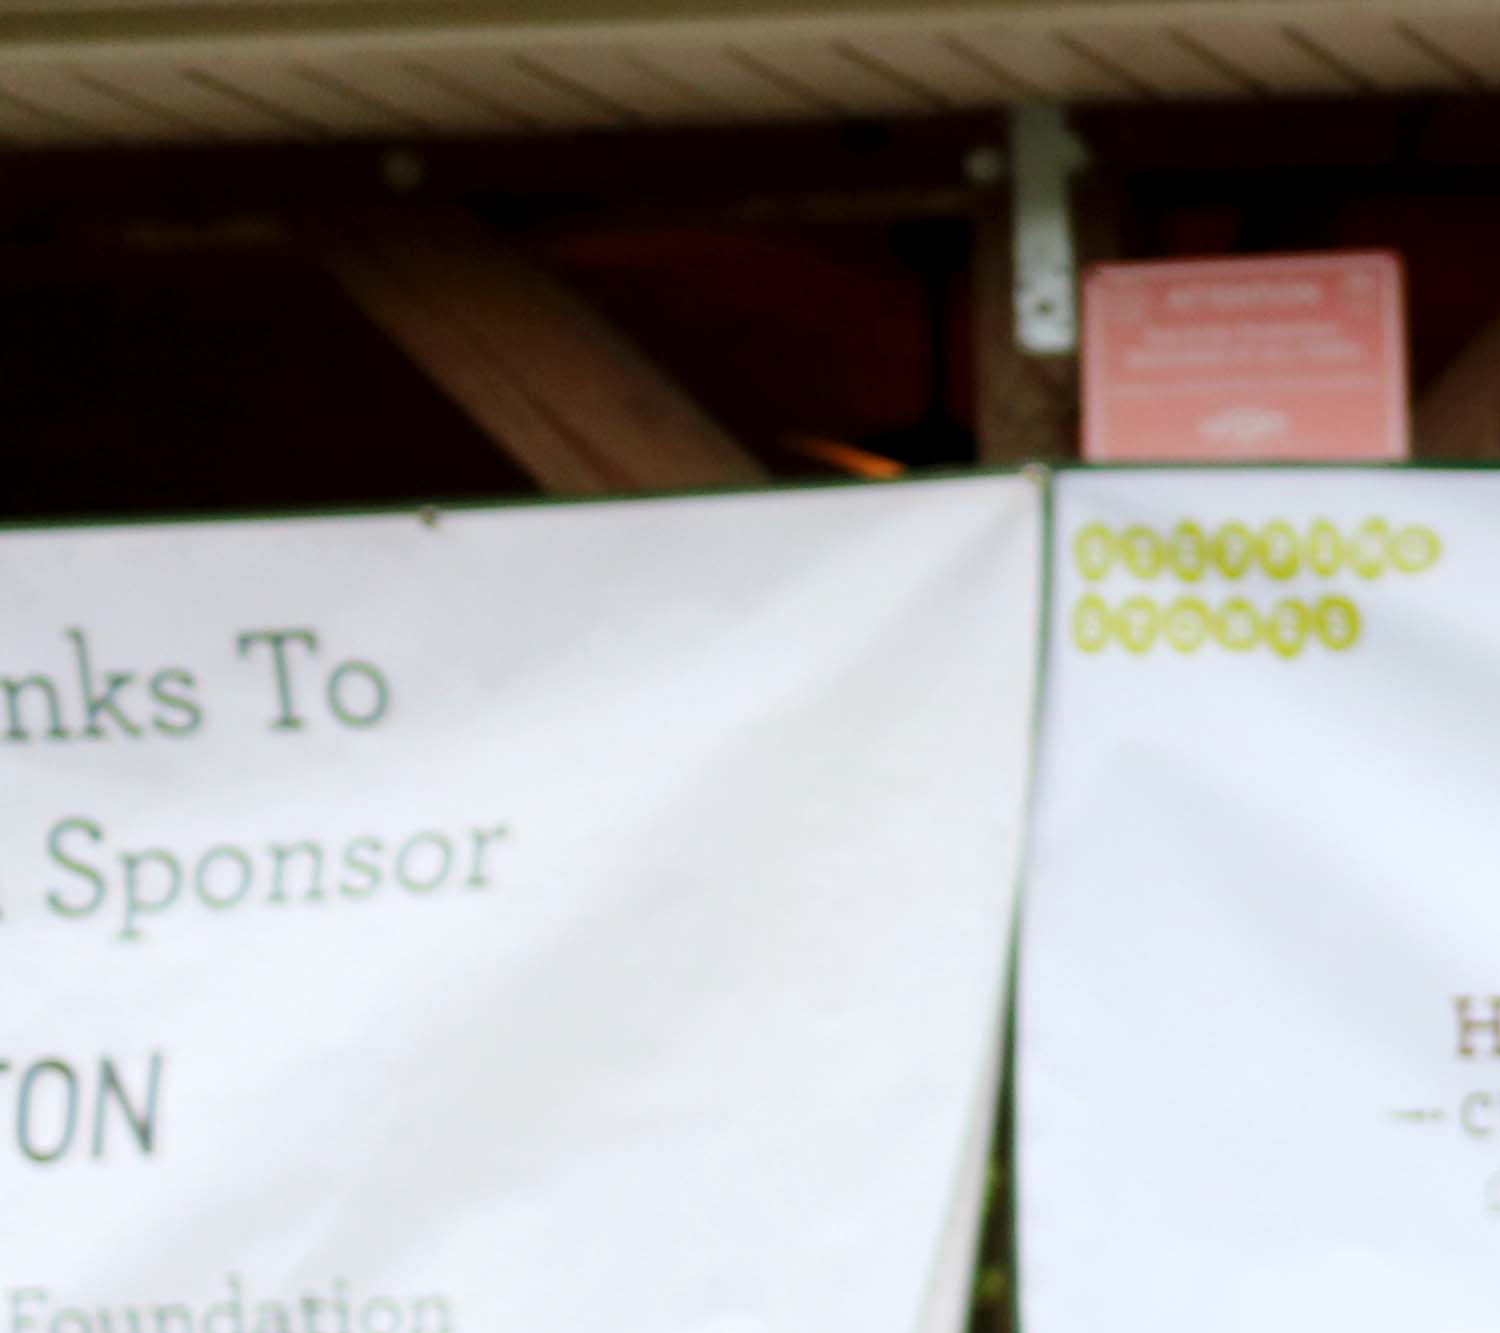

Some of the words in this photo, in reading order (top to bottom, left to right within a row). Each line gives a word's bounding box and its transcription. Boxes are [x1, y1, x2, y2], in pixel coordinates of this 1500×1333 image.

[0, 626, 205, 744] nks
[234, 627, 392, 734] To
[44, 814, 510, 944] Sponsor
[0, 1050, 163, 1167] ON
